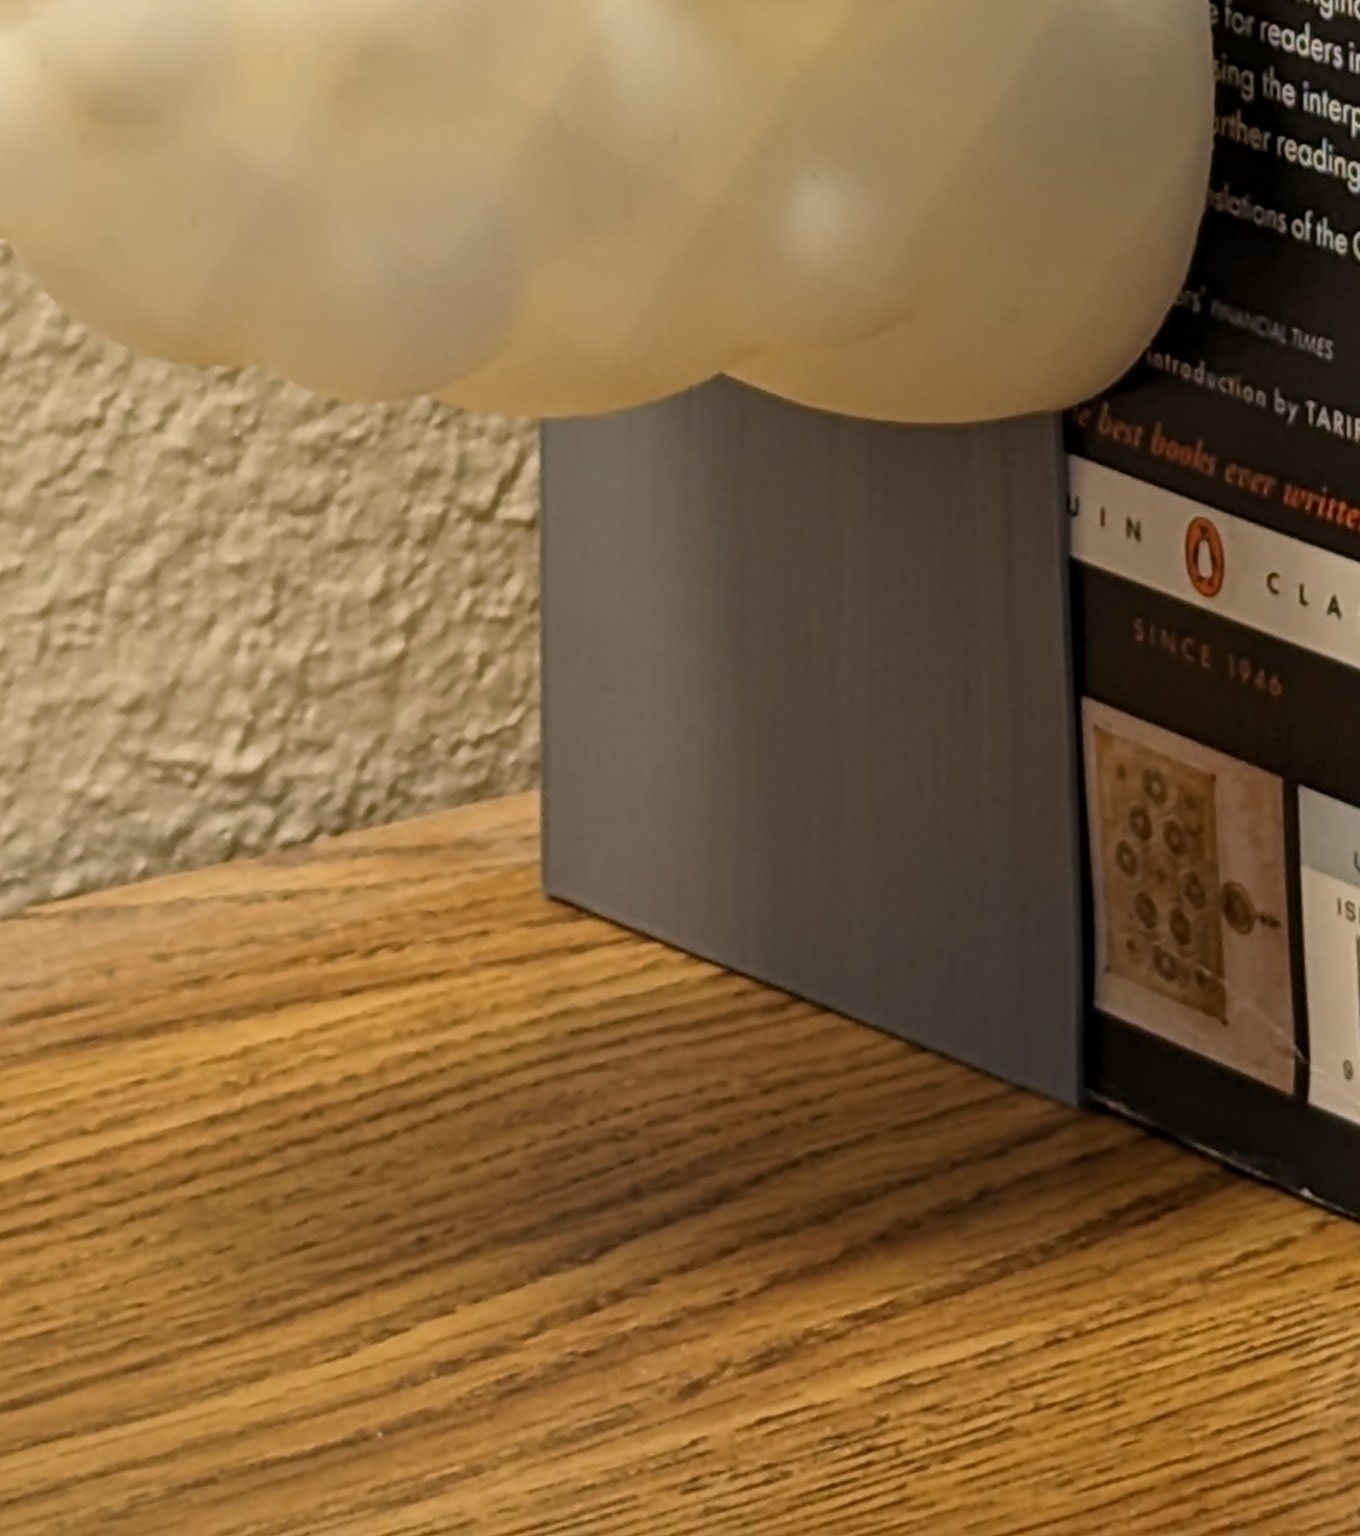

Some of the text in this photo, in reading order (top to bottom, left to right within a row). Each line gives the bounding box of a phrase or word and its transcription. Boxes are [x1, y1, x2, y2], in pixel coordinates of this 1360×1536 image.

[1261, 21, 1344, 69] readers
[1262, 67, 1296, 108] the
[1290, 209, 1313, 242] of
[1315, 217, 1348, 255] the
[1273, 387, 1299, 424] by
